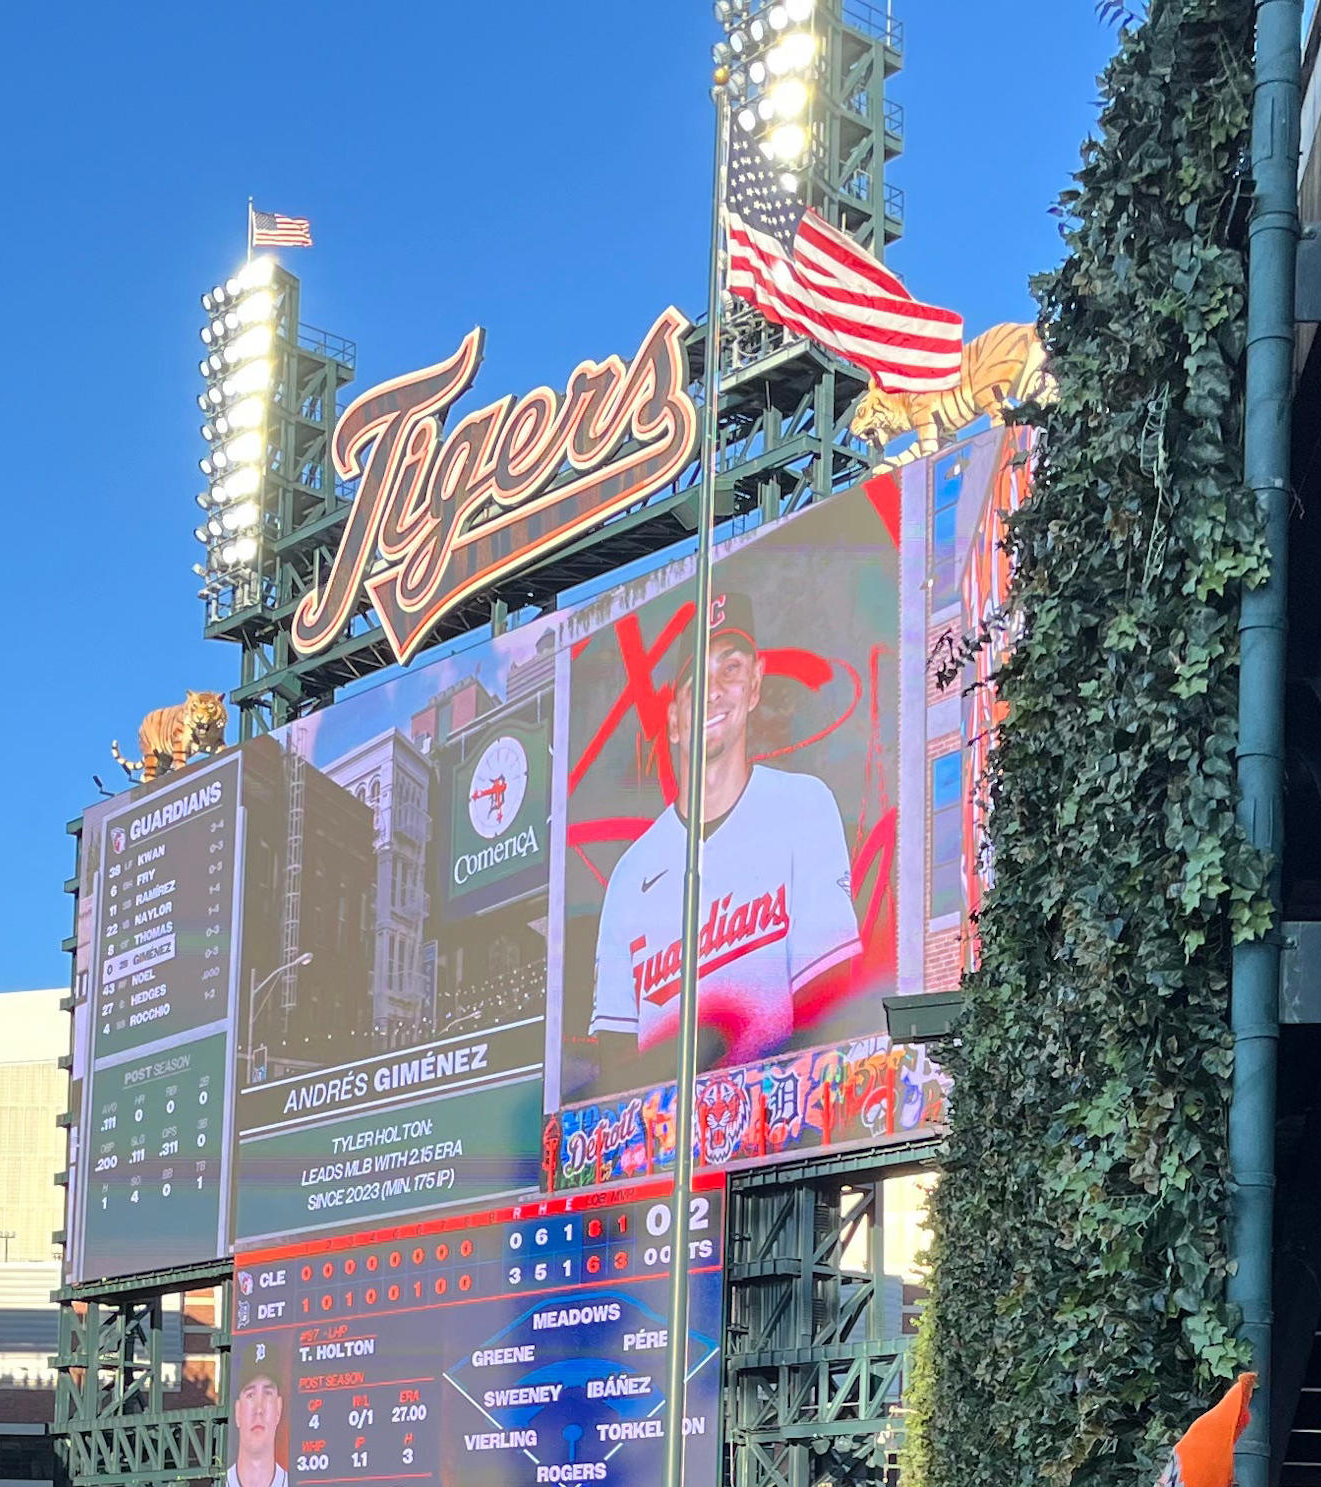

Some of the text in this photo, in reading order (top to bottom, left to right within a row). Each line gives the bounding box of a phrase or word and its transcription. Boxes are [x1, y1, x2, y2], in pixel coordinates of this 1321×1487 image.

[290, 304, 699, 665] Tigers
[130, 781, 222, 841] GUARDIANS
[137, 844, 166, 867] KWAN
[136, 868, 156, 887] FRY
[135, 879, 176, 907] RAMÍREZ
[134, 901, 173, 926] NAYLOR
[134, 920, 173, 946] THOMAS
[629, 883, 790, 1015] Guadians
[131, 969, 156, 987] NOEL
[131, 984, 166, 1006] HEDGES
[130, 1003, 170, 1027] ROCCHIO
[123, 1054, 191, 1085] POST SEASON
[283, 1043, 488, 1114] ANDRÉS GIMÉNEZ
[134, 1108, 143, 1122] 0
[166, 1099, 175, 1113] 0
[199, 1091, 208, 1105] 0
[331, 1118, 433, 1155] TYLER HOLTON:
[563, 1097, 643, 1179] Detroit
[94, 1155, 118, 1173] .200
[158, 1140, 179, 1157] .311
[197, 1133, 206, 1147] 0
[301, 1139, 463, 1187] LEADS MLB WITH 2.15 ERA
[102, 1175, 203, 1210] 1 4 0 1
[307, 1168, 455, 1211] SINCE 2023 (MIN. 175 IP)
[512, 1199, 574, 1220] R H E
[259, 1215, 627, 1288] CLE 0 0 0 0 0 0 0 0 0 6 1 1
[644, 1240, 713, 1266] 0 OTS
[257, 1251, 628, 1320] DET 1 0 1 0 0 1 0 0 3 5 1 6 3
[532, 1303, 621, 1331] MEADOWS
[299, 1339, 375, 1362] T. HOLTON
[623, 1329, 668, 1351] PÉRE
[471, 1345, 535, 1367] GREENE
[299, 1372, 365, 1389] POST SEASON
[586, 1374, 652, 1399] IBÁÑEZ
[399, 1389, 420, 1403] ERA
[483, 1384, 563, 1408] SWEENEY
[308, 1404, 427, 1430] 4 0/1 27.00
[596, 1417, 705, 1442] TORKELON
[464, 1430, 538, 1451] VIERLING
[296, 1454, 329, 1472] 3.00
[402, 1448, 414, 1464] 3
[536, 1462, 607, 1483] ROGERS
